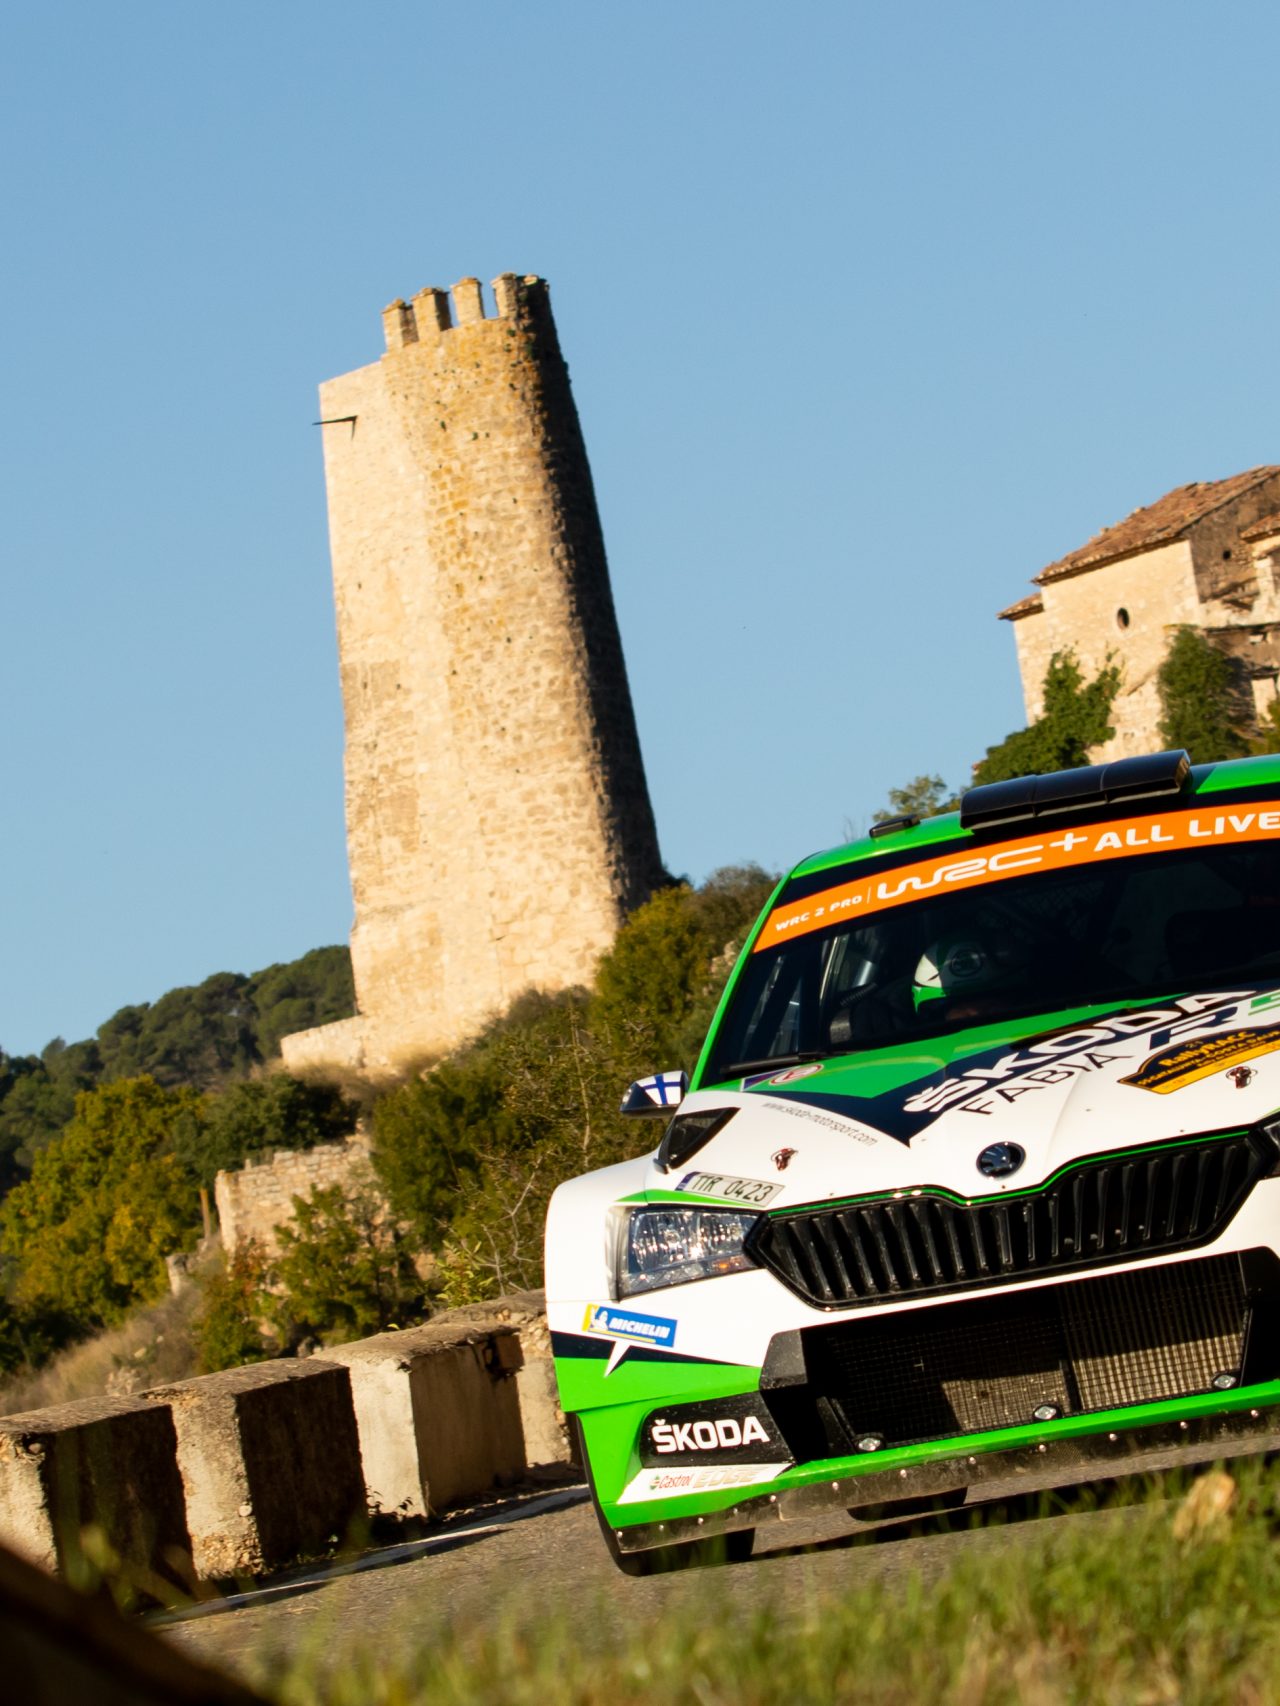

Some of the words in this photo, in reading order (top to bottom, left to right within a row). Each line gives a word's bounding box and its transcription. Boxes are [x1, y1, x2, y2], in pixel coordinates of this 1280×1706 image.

[775, 911, 810, 932] WRC
[814, 907, 825, 918] 2
[829, 895, 863, 913] PRO
[1093, 825, 1174, 852] ALL
[957, 1052, 1135, 1115] FABIA
[723, 1179, 774, 1202] 0423
[609, 1317, 671, 1339] MICHELIN
[651, 1416, 770, 1453] ŠKODA
[658, 1474, 694, 1489] Castrol
